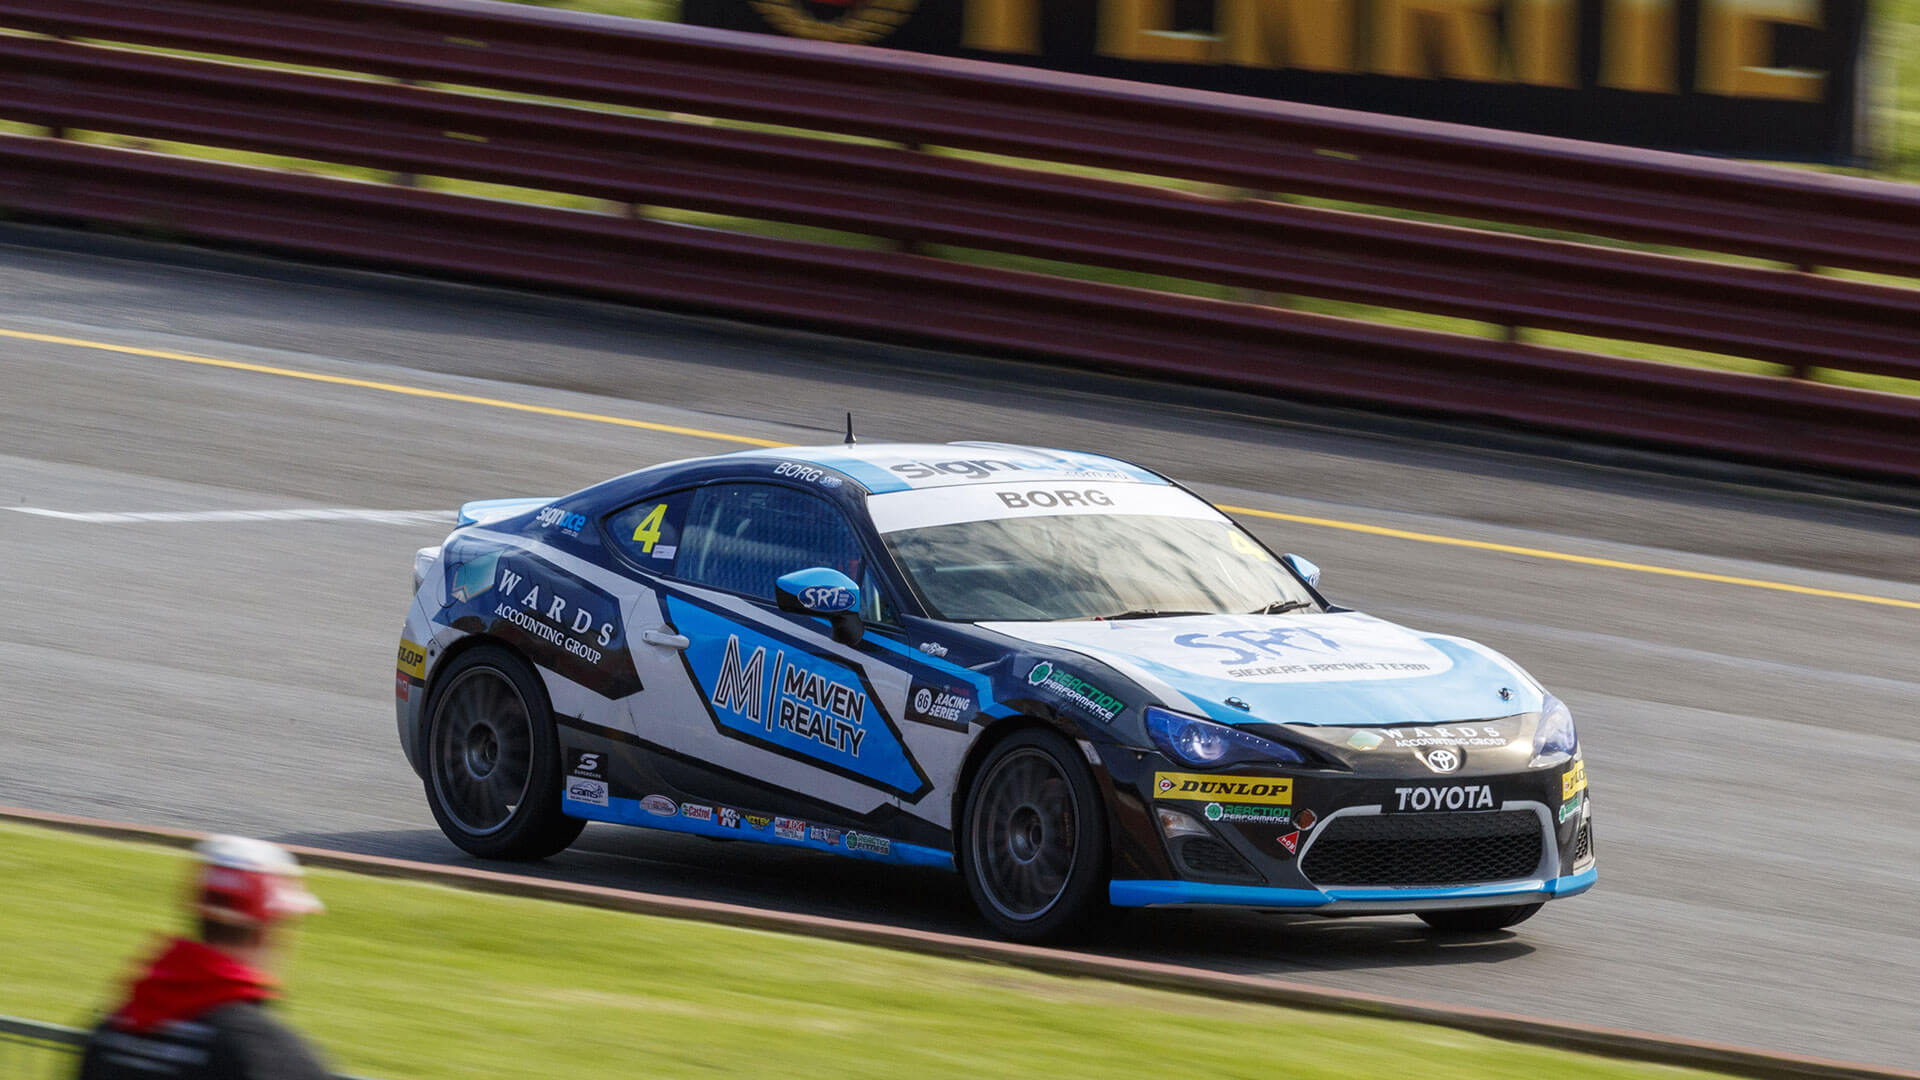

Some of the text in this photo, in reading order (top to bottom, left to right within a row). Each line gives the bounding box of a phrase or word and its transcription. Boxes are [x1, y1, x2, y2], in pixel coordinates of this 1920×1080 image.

[774, 462, 823, 482] BORG
[996, 489, 1115, 509] BORG
[536, 503, 586, 532] signace
[632, 504, 668, 553] 4
[498, 568, 614, 647] WARDS
[804, 586, 846, 609] SRT
[494, 602, 602, 665] ACCOUNTING GROUP
[1174, 626, 1342, 665] SRT
[399, 645, 424, 668] LOP
[1227, 661, 1431, 679] SIEDERS RACING TEAM
[782, 662, 866, 725] MAVEN
[916, 693, 930, 709] 86
[934, 692, 971, 711] RACING
[1043, 678, 1115, 720] PERFORMANCE
[1049, 669, 1124, 714] REACTION
[928, 704, 961, 722] SERIES
[778, 698, 866, 758] REALTY
[1381, 727, 1501, 739] WARDS
[1395, 737, 1508, 747] ACCOUNTING GROUP
[1179, 780, 1289, 797] DUNLOP
[1394, 784, 1494, 811] TOYOTA
[688, 805, 711, 820] Castrol
[1223, 804, 1292, 817] REACTION
[1223, 813, 1291, 823] PERFORMANCE
